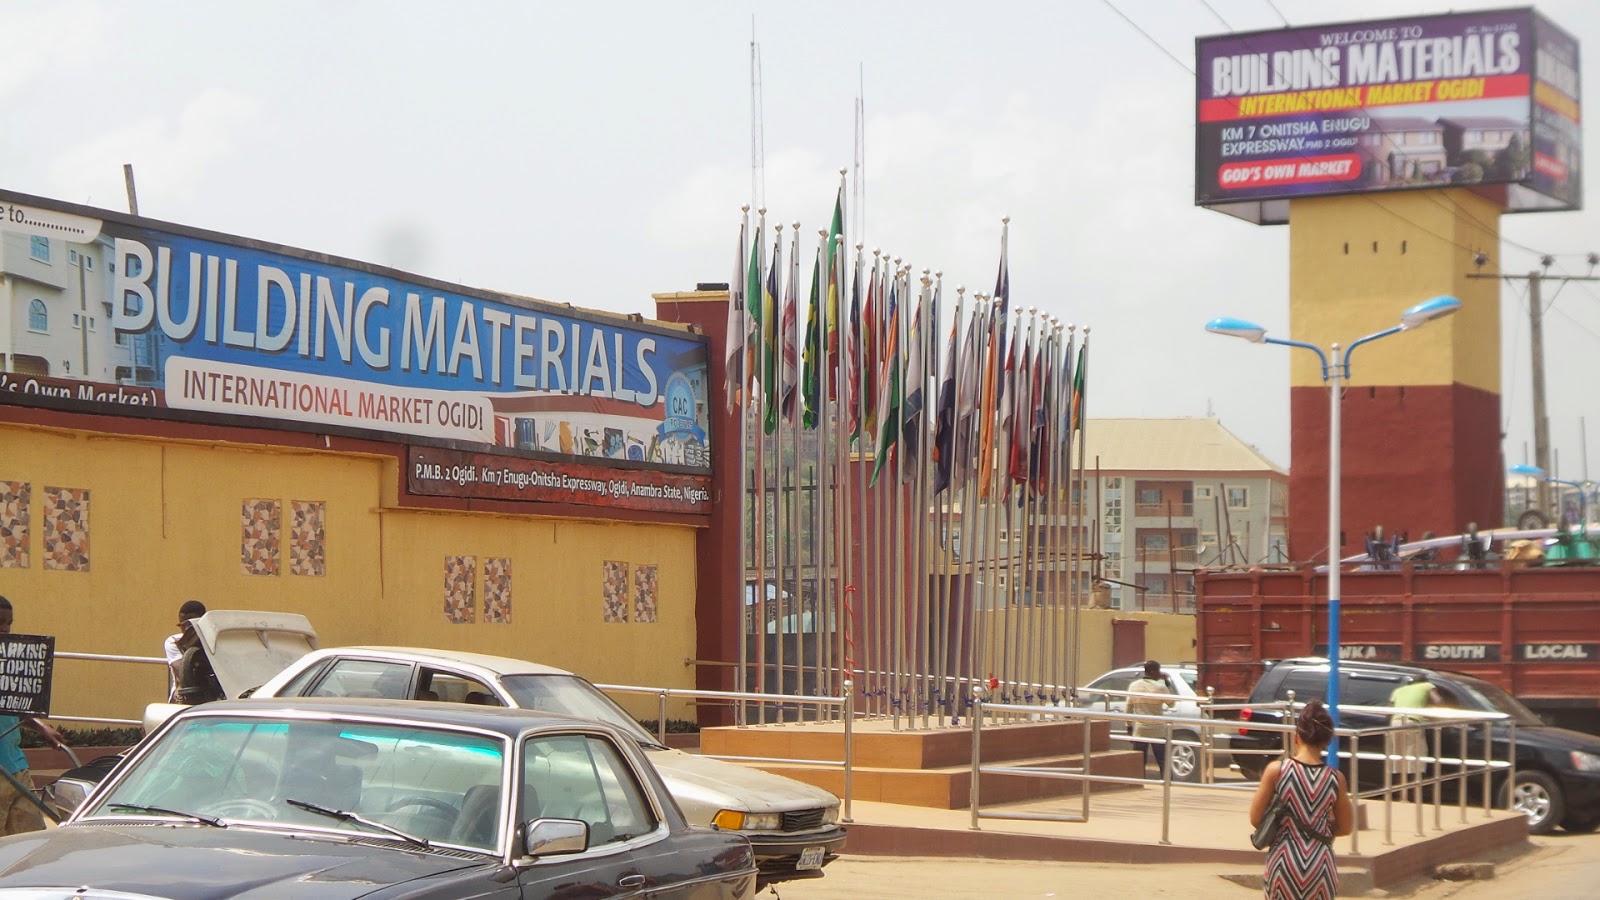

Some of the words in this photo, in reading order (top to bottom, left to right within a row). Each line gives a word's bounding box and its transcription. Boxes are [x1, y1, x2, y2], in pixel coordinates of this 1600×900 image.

[1321, 28, 1398, 46] WELCOME
[1402, 25, 1423, 39] TO
[1212, 46, 1341, 97] BUILDING
[1348, 31, 1520, 85] MATERIALS
[1239, 86, 1362, 117] INTERNATIONAL
[1366, 81, 1435, 106] MARKET
[1436, 77, 1486, 100] OGIDI
[1222, 128, 1243, 141] KM
[1250, 126, 1256, 139] 7
[1260, 121, 1319, 137] ONITSHA
[1322, 117, 1371, 133] ENUGU
[1222, 167, 1261, 183] GOD'S
[1264, 163, 1295, 180] OWN
[1299, 159, 1352, 176] MARKET
[115, 237, 390, 370] BUILDING
[401, 293, 658, 407] MATERIALS
[183, 369, 353, 417] INTERNATIONAL
[358, 392, 433, 425] MARKET
[437, 400, 483, 431] OGIDI
[672, 396, 688, 415] CAC
[416, 463, 444, 480] P.M.B.
[445, 468, 451, 480] 2
[452, 465, 478, 486] Ogidi.
[481, 467, 496, 483] Km
[496, 471, 502, 486] 7
[503, 469, 561, 490] Enugu-Onitsha
[562, 474, 608, 496] Expressway,
[608, 479, 630, 499] Ogidi,
[630, 481, 662, 498] Anambra
[663, 485, 683, 502] State,
[683, 486, 710, 505] Nigeria.
[1425, 645, 1486, 659] SOUTH
[1525, 645, 1588, 659] LOCAL
